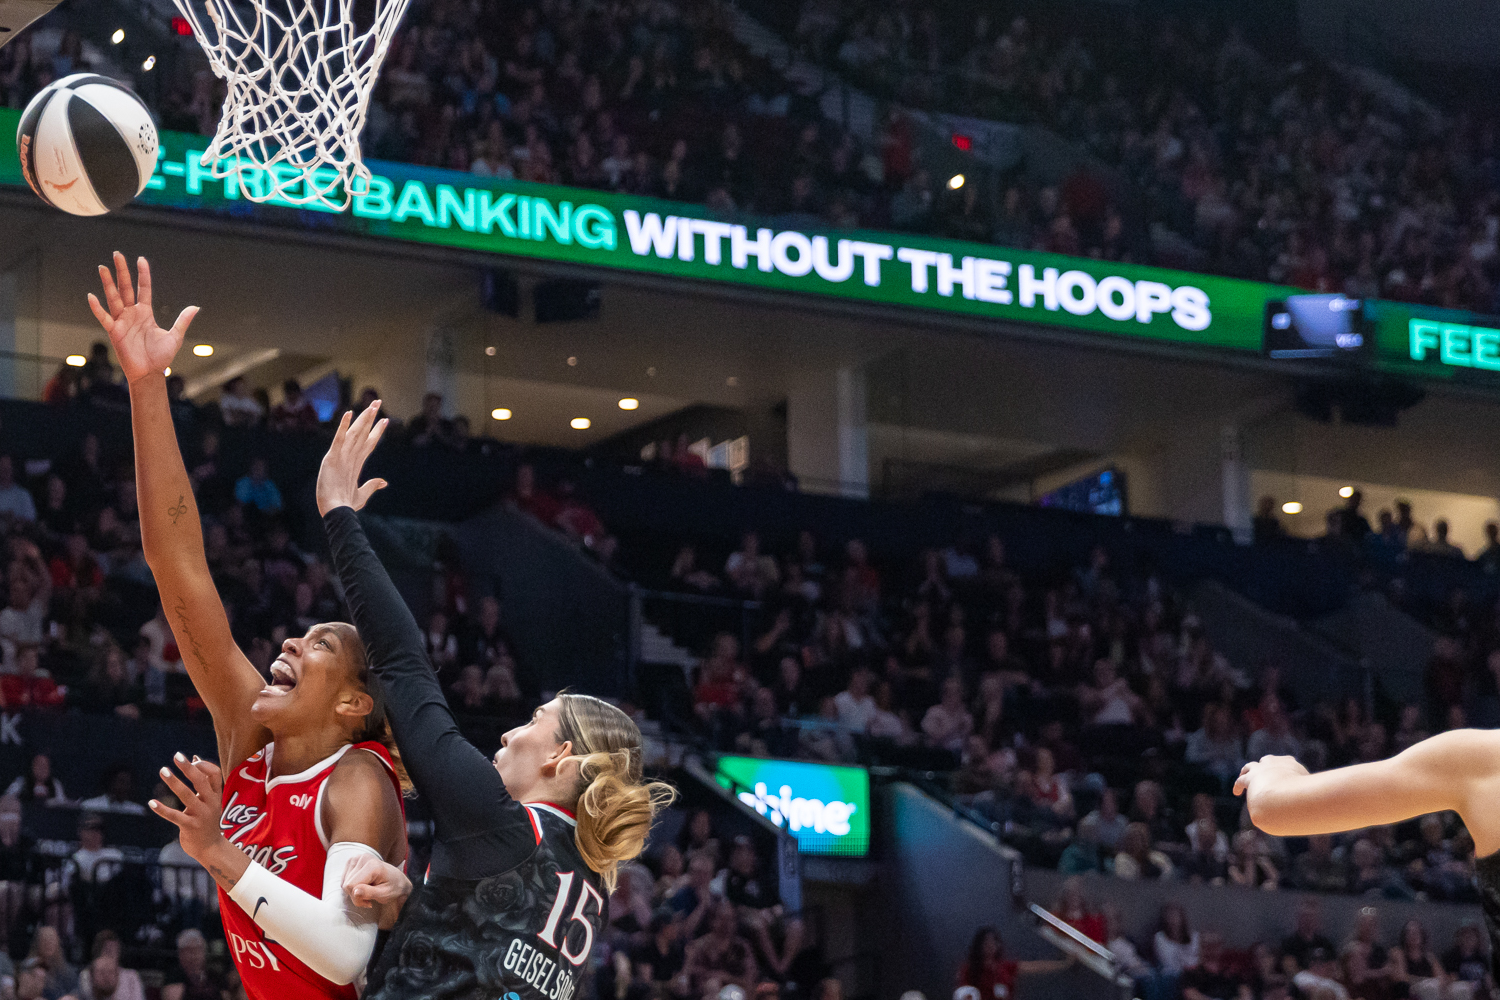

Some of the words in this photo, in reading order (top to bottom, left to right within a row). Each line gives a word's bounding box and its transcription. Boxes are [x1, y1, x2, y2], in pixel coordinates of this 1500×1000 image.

[352, 174, 618, 251] BANKING
[623, 209, 894, 287] WITHOUT
[897, 246, 1013, 306] THE
[1017, 263, 1212, 332] HOOPS
[220, 790, 259, 830] Las
[536, 877, 605, 967] 15
